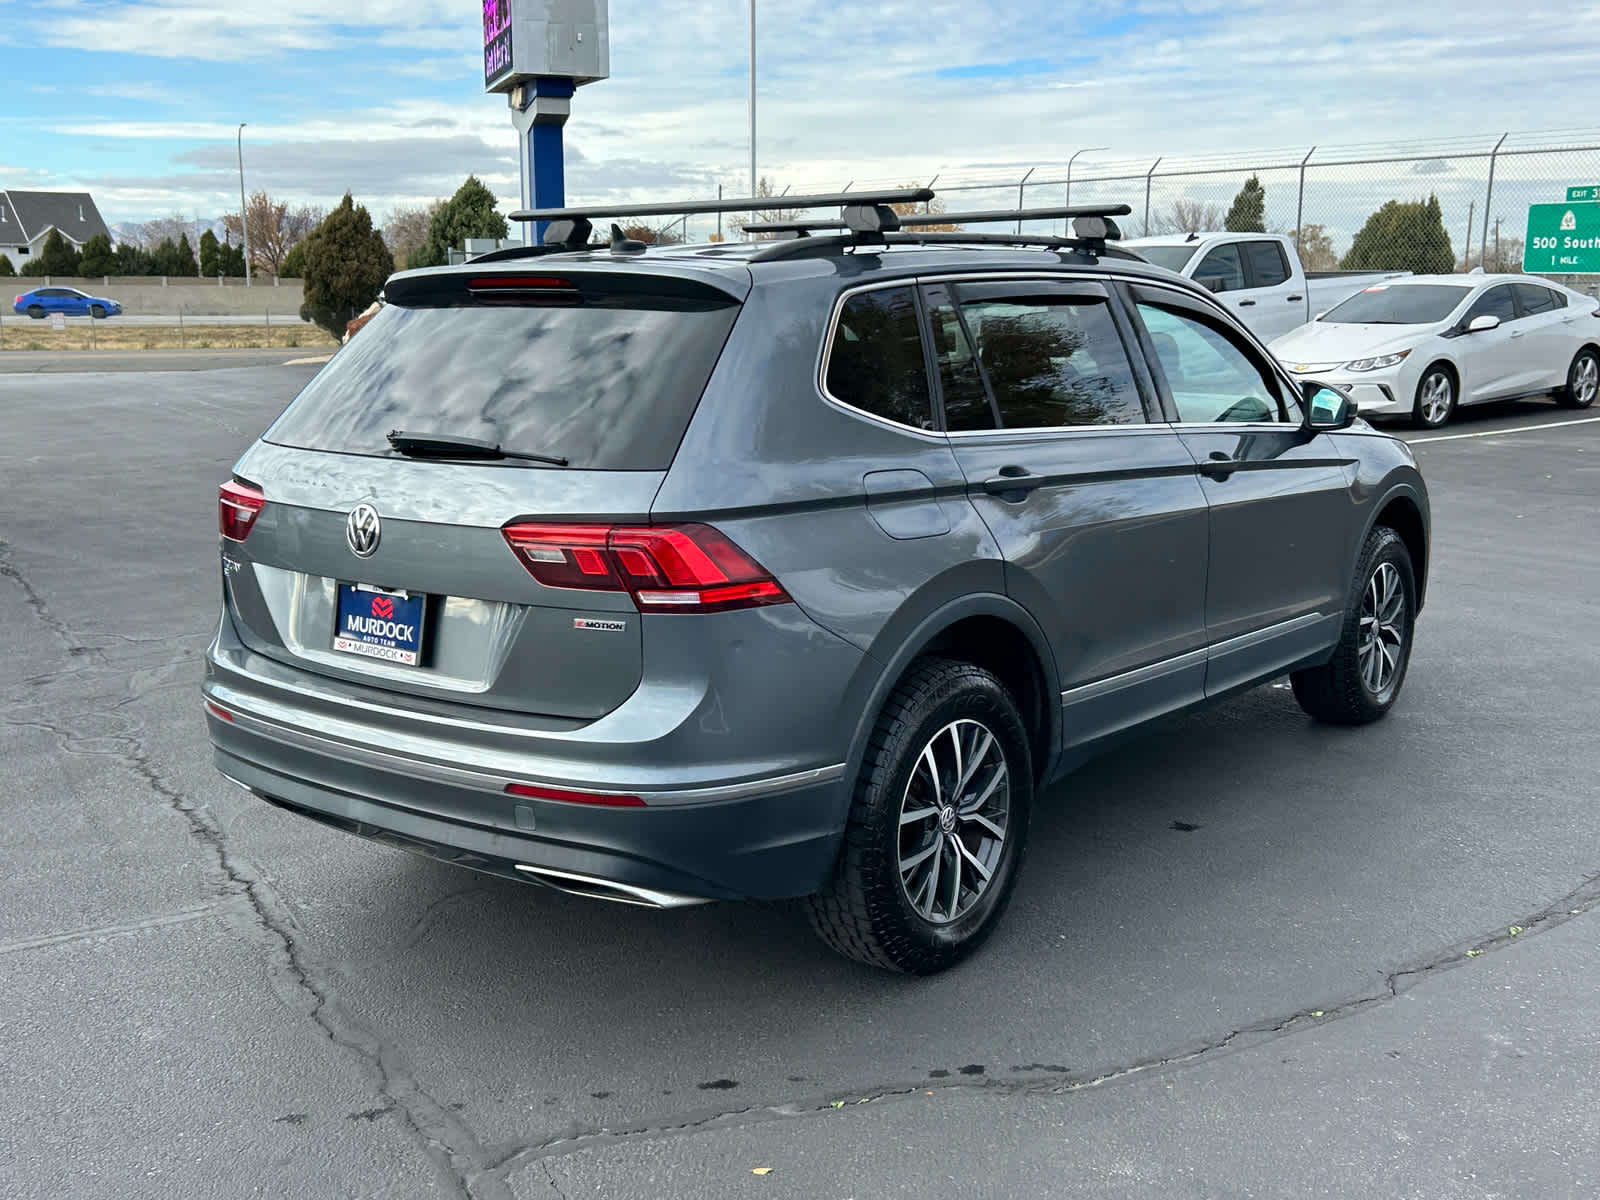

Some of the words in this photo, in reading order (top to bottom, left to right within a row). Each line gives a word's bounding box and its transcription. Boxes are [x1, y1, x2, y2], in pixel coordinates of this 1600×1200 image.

[1571, 190, 1587, 198] EXIT
[1592, 188, 1600, 198] 3
[1533, 236, 1557, 249] 500
[1564, 236, 1600, 249] South
[1551, 255, 1555, 266] 1
[1560, 255, 1579, 265] MILE
[347, 614, 414, 643] MURDOCK
[362, 635, 379, 644] AUTO
[380, 638, 396, 647] TEAM
[353, 642, 399, 660] MURDOCK
